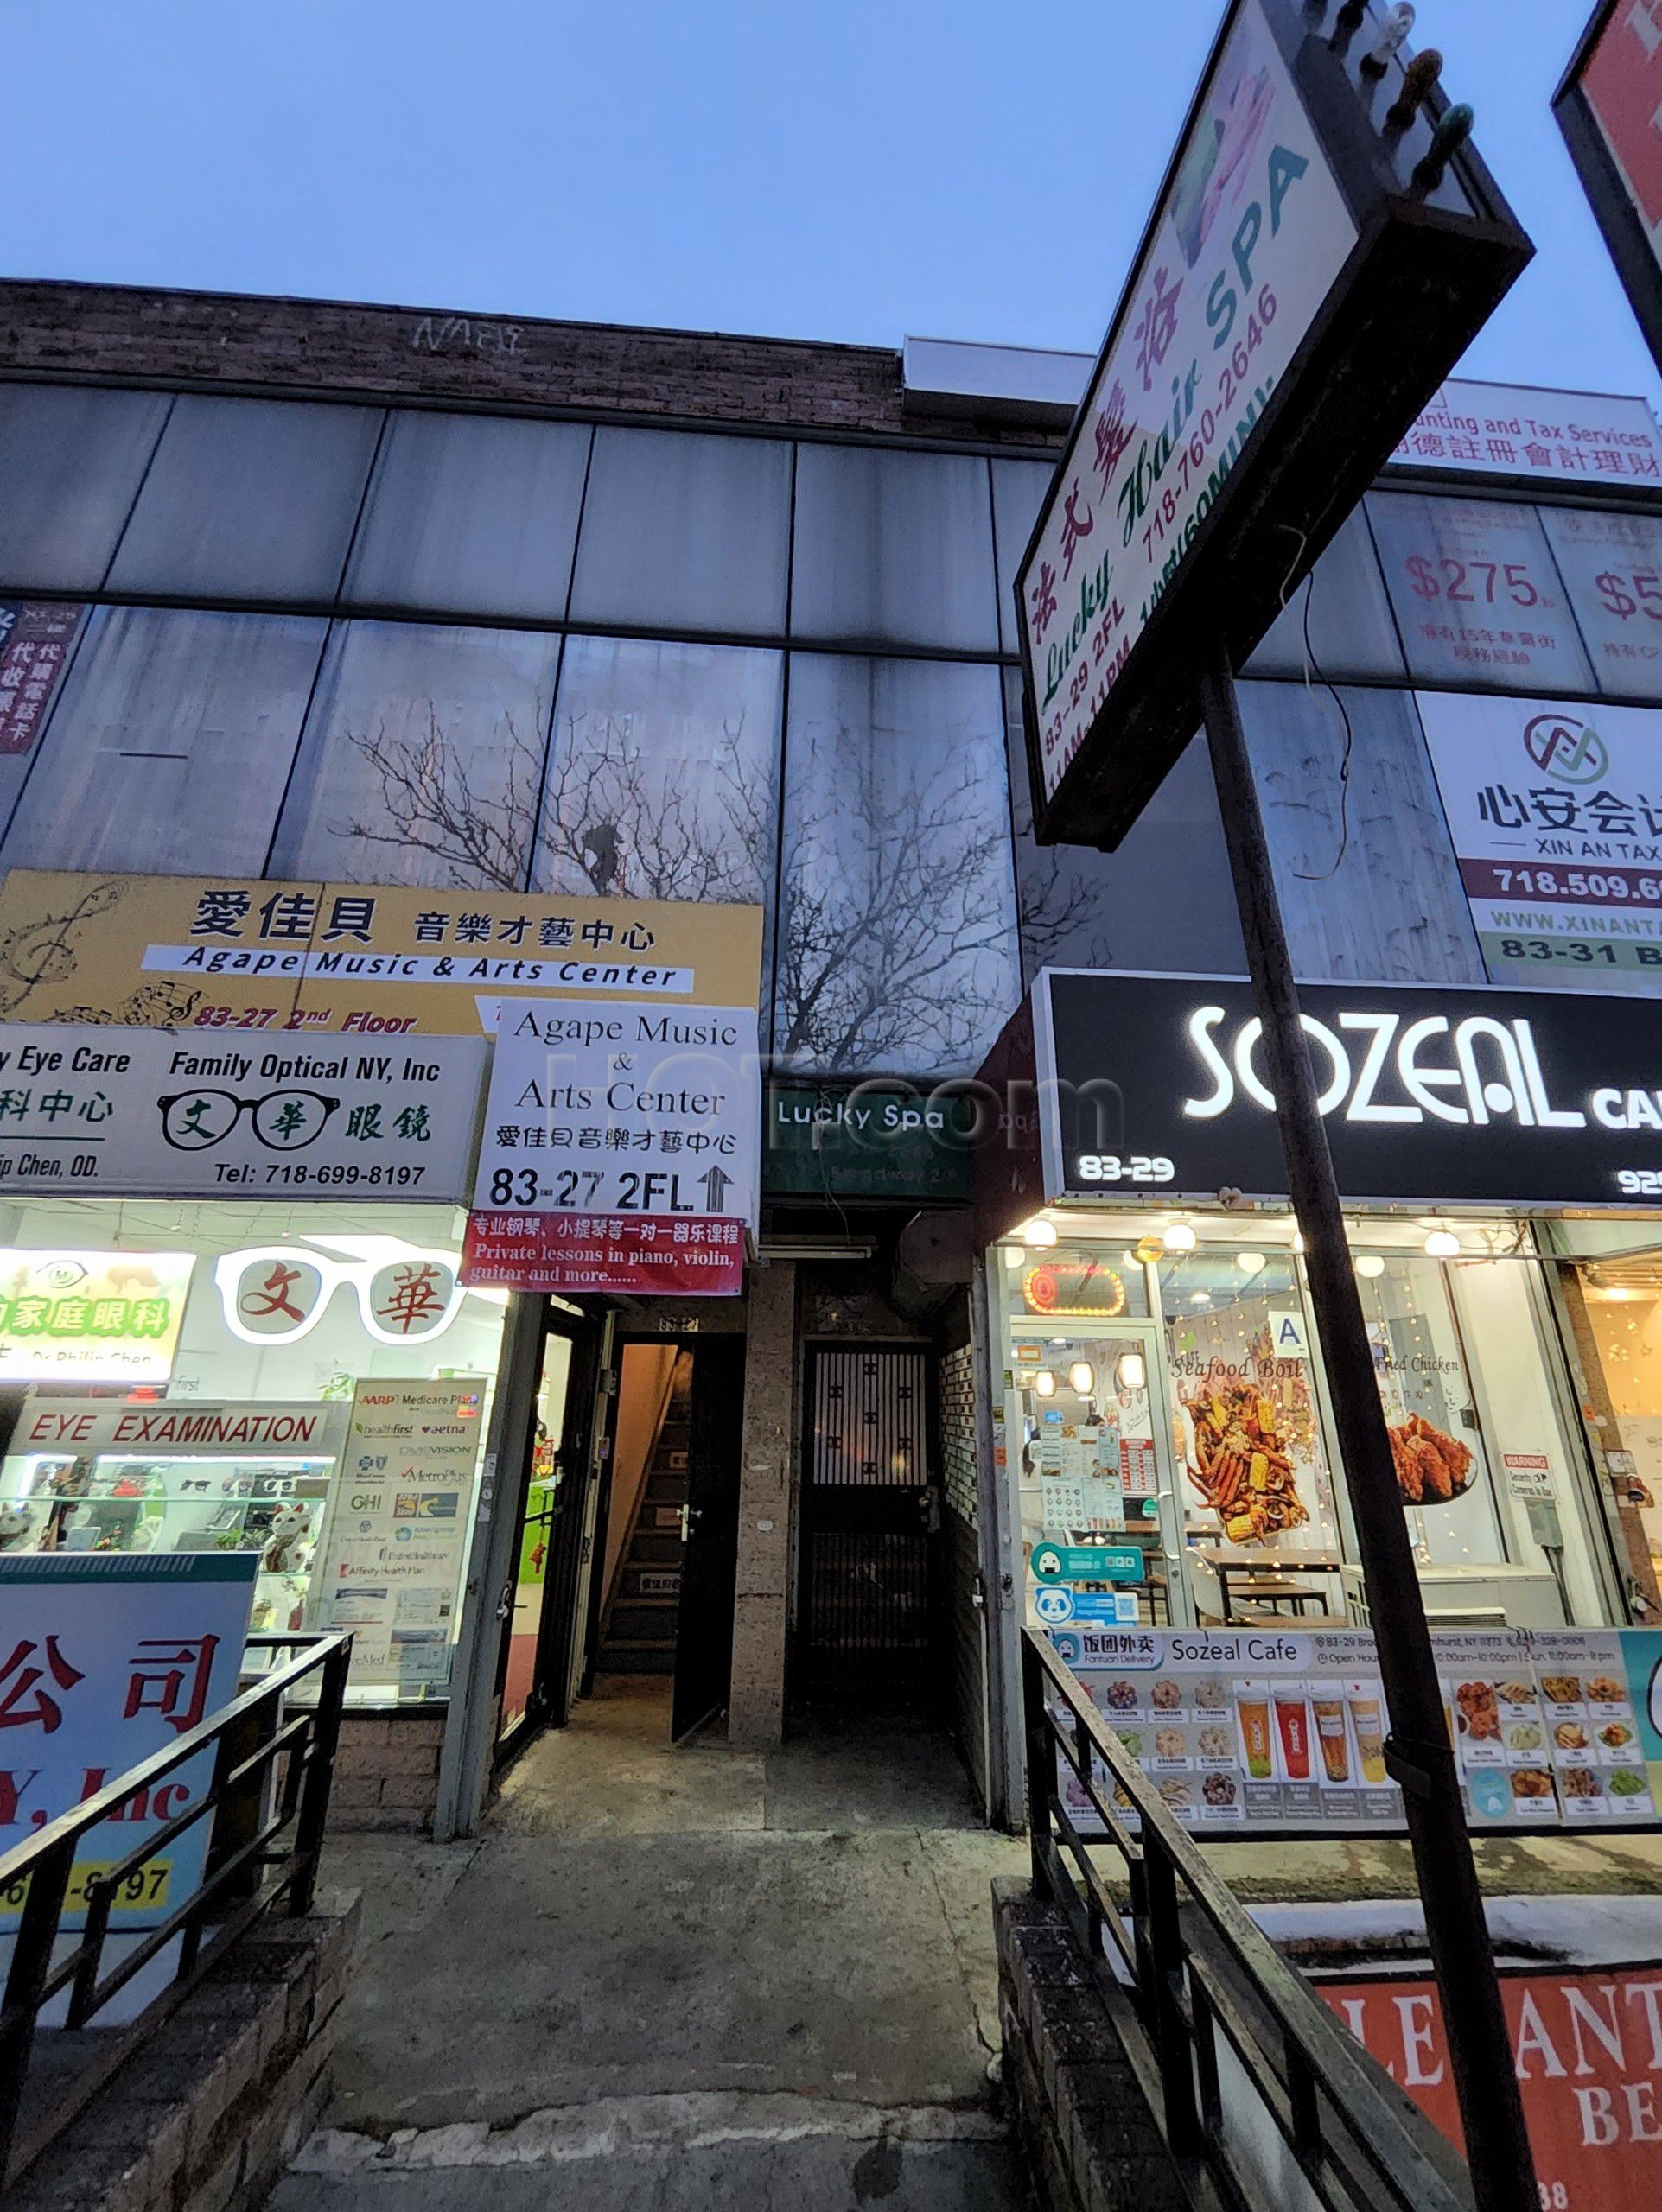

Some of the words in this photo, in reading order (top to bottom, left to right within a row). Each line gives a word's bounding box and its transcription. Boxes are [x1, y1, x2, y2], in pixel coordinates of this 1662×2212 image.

[1041, 548, 1114, 716] Lucky
[1118, 358, 1202, 549] Hair
[1206, 144, 1309, 351] SPA
[1485, 415, 1522, 435] and
[1526, 420, 1563, 439] Tax
[1568, 423, 1652, 448] Services
[1046, 660, 1088, 756] 83-29
[1092, 595, 1125, 667] 2FL
[1143, 283, 1277, 564] 718-760-2646
[1404, 555, 1538, 607] $275
[1534, 839, 1574, 856] XIN
[1582, 842, 1610, 859] AN
[189, 889, 375, 944] 愛佳貝
[414, 911, 655, 951] 音樂才藝中心
[1490, 911, 1662, 935] WWW.XINANT
[1500, 939, 1617, 963] 83-31
[182, 945, 299, 971] Agape
[315, 950, 419, 976] Music
[432, 956, 455, 976] &
[468, 957, 542, 981] Arts
[558, 961, 677, 987] Center
[194, 1005, 271, 1029] 83-27
[283, 1007, 332, 1030] 2nd
[341, 1010, 417, 1034] Floor
[513, 1010, 623, 1047] Agape
[636, 1014, 737, 1046] Music
[17, 1046, 63, 1077] Eye
[71, 1046, 131, 1073] Care
[169, 1051, 253, 1083] Family
[259, 1054, 347, 1084] Optical
[354, 1058, 393, 1084] NY,
[400, 1058, 441, 1083] Inc
[612, 1052, 634, 1071] &
[514, 1078, 593, 1110] Arts
[606, 1081, 726, 1116] Center
[1592, 1087, 1662, 1130] CA
[777, 1101, 872, 1130] Lucky
[882, 1103, 945, 1132] Spa
[496, 1124, 737, 1154] 愛佳貝音樂才藝中心
[17, 1153, 64, 1179] Chen,
[70, 1154, 99, 1178] OD.
[213, 1163, 257, 1184] Tel:
[264, 1164, 426, 1186] 718-699-8197
[1077, 1154, 1176, 1183] 83-29
[488, 1167, 605, 1208] 83-27
[615, 1171, 694, 1212] 2FL
[474, 1242, 537, 1261] Private
[540, 1244, 603, 1262] lessons
[608, 1246, 624, 1262] in
[627, 1248, 679, 1268] piano,
[683, 1249, 735, 1268] violin,
[469, 1263, 525, 1282] guitar
[528, 1266, 561, 1282] and
[1278, 1318, 1302, 1345] A
[1170, 1354, 1254, 1383] Seafood
[1258, 1356, 1306, 1379] Boil
[1410, 1355, 1460, 1376] Chicken
[359, 1395, 396, 1406] AARP
[401, 1395, 448, 1405] Medicare
[29, 1414, 98, 1441] EYE
[111, 1414, 318, 1443] EXAMINATION
[430, 1424, 467, 1434] aetna
[1172, 1638, 1242, 1662] Sozeal
[1248, 1640, 1297, 1661] Cafe
[1329, 1653, 1356, 1665] Open
